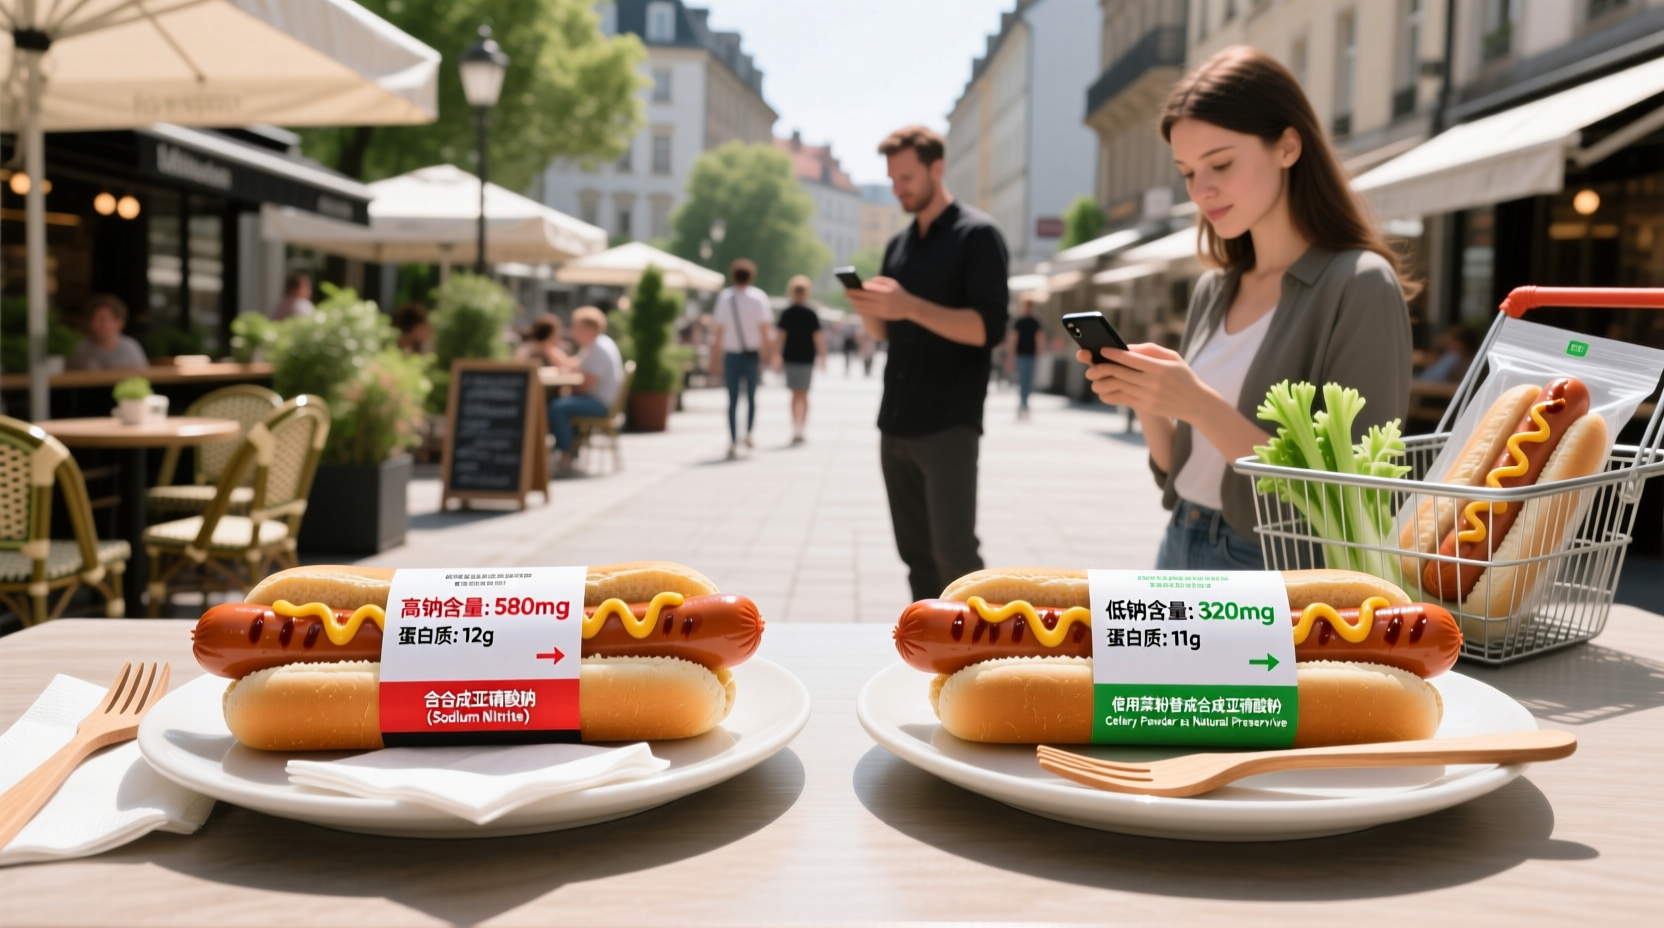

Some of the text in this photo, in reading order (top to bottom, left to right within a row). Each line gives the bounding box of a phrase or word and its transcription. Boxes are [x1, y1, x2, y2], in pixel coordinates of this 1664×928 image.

[401, 597, 570, 620] 高钠含量: 580mg
[1106, 599, 1275, 625] 低钠含量: 320mg
[399, 626, 494, 647] 蛋白质: 12g
[1107, 628, 1201, 650] 蛋白质: 11g
